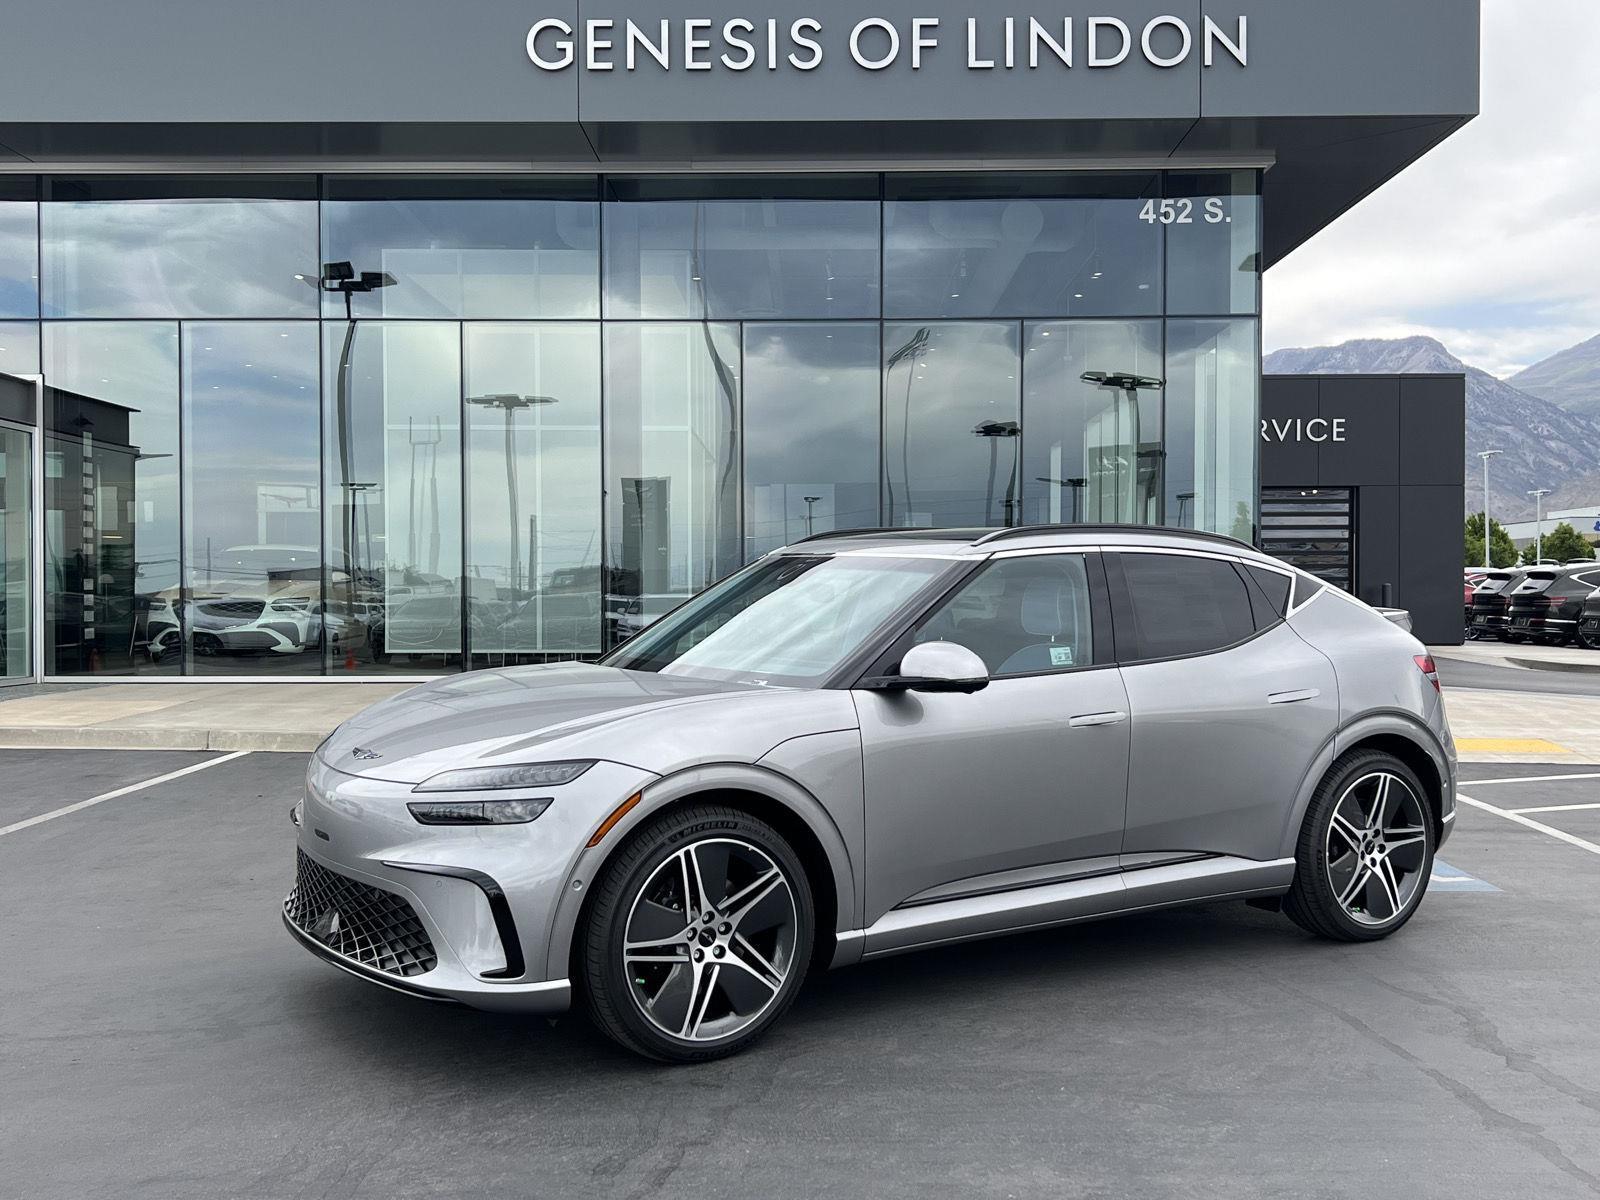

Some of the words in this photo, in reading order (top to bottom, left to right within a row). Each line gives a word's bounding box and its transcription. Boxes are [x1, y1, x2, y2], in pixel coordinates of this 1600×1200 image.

[526, 18, 823, 70] GENESIS
[849, 17, 939, 70] OF
[967, 15, 1247, 68] LINDON
[1139, 199, 1193, 224] 452
[1204, 198, 1231, 223] S.
[683, 821, 738, 837] MICHELIN
